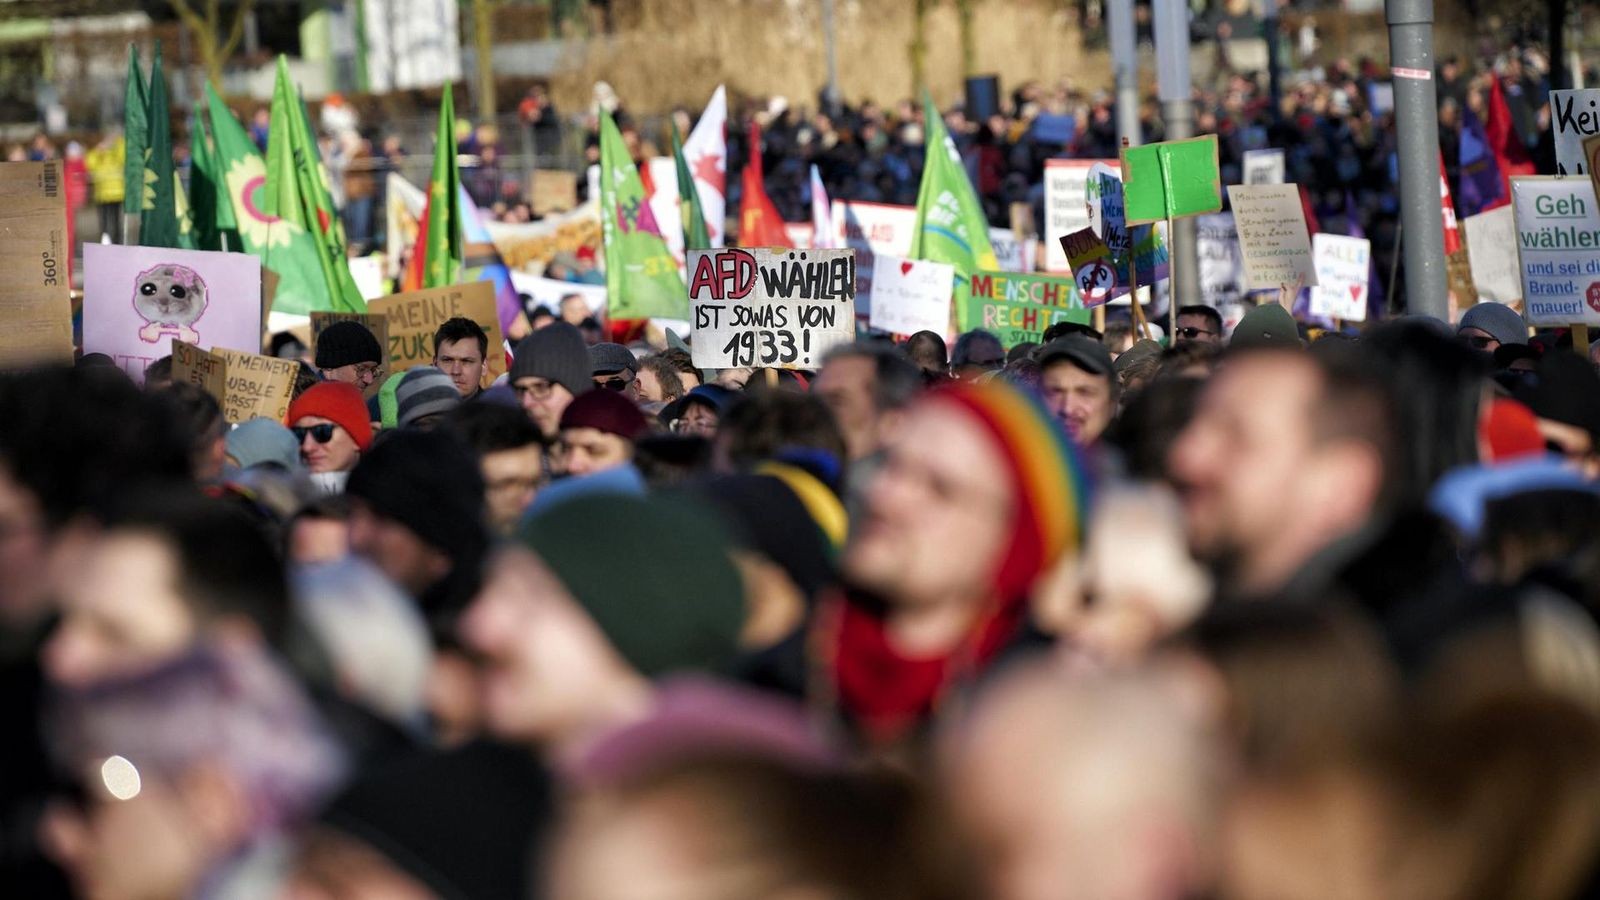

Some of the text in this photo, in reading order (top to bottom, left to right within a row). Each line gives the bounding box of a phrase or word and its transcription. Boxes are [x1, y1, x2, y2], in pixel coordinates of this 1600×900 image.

[1553, 93, 1600, 136] Kei
[1536, 193, 1586, 215] Geh
[1065, 232, 1102, 259] BUN
[42, 252, 57, 287] 360°
[690, 249, 758, 299] AFD
[760, 252, 855, 302] WÄHLEN
[1527, 259, 1600, 274] und sei di
[972, 275, 1085, 309] MENSCHEN
[1529, 280, 1579, 293] Brand-
[386, 293, 462, 328] MEINE
[695, 304, 835, 329] IST SOWAS VON
[1531, 299, 1583, 313] mauer!
[390, 332, 434, 361] ZUK
[723, 329, 811, 367] 1933!
[178, 345, 218, 376] SO HAT
[238, 355, 290, 375] MEINER
[227, 377, 275, 398] UBBLE
[226, 394, 259, 409] ASST
